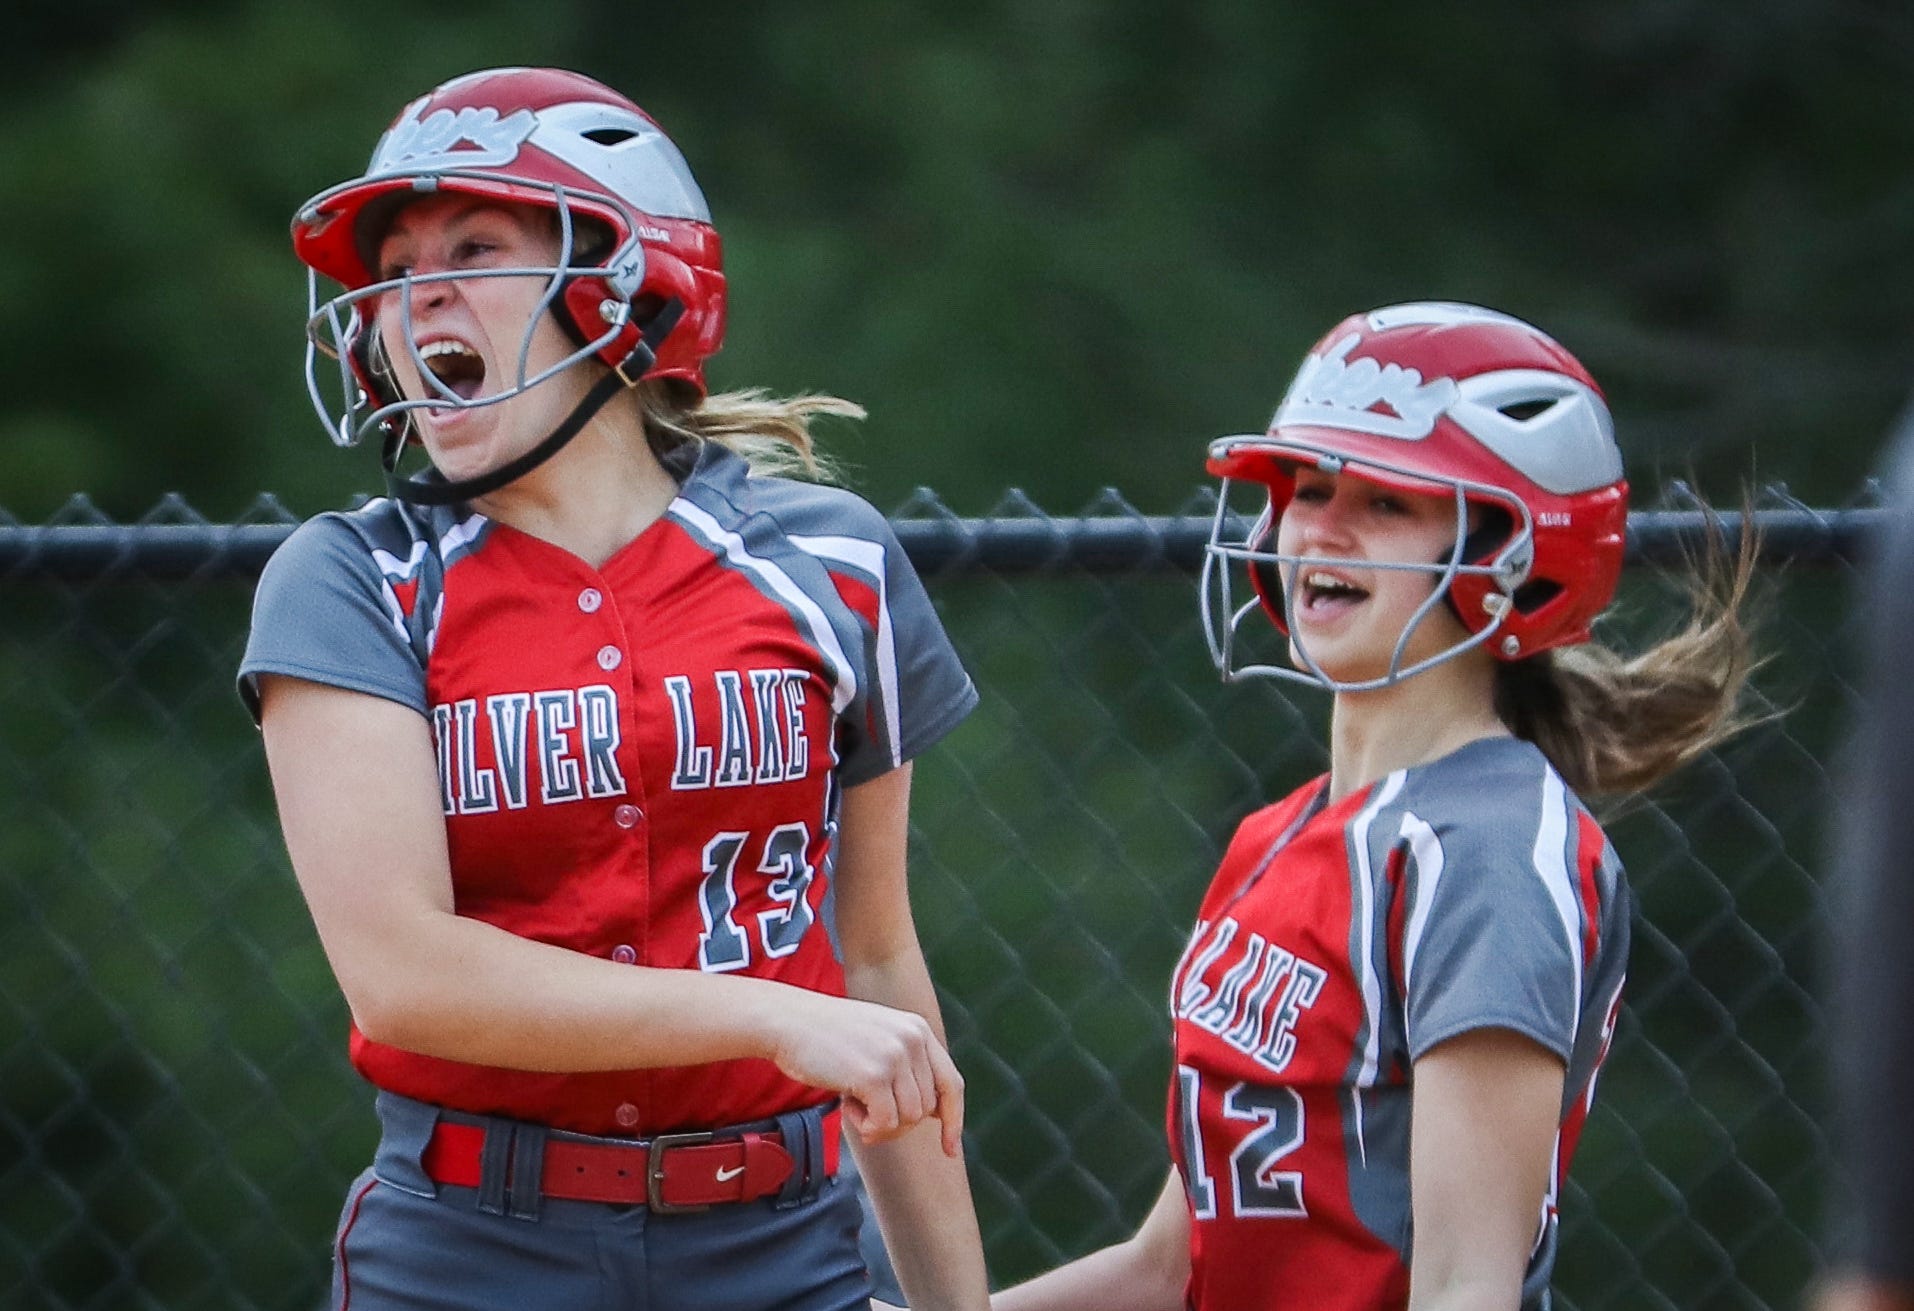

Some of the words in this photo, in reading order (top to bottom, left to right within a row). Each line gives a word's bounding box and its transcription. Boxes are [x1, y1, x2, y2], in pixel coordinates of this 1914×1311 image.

[433, 684, 627, 815] ILVER
[664, 668, 811, 790] LAKE
[699, 821, 815, 972] 13
[1178, 916, 1328, 1074] LAKE
[1178, 1064, 1309, 1219] 12
